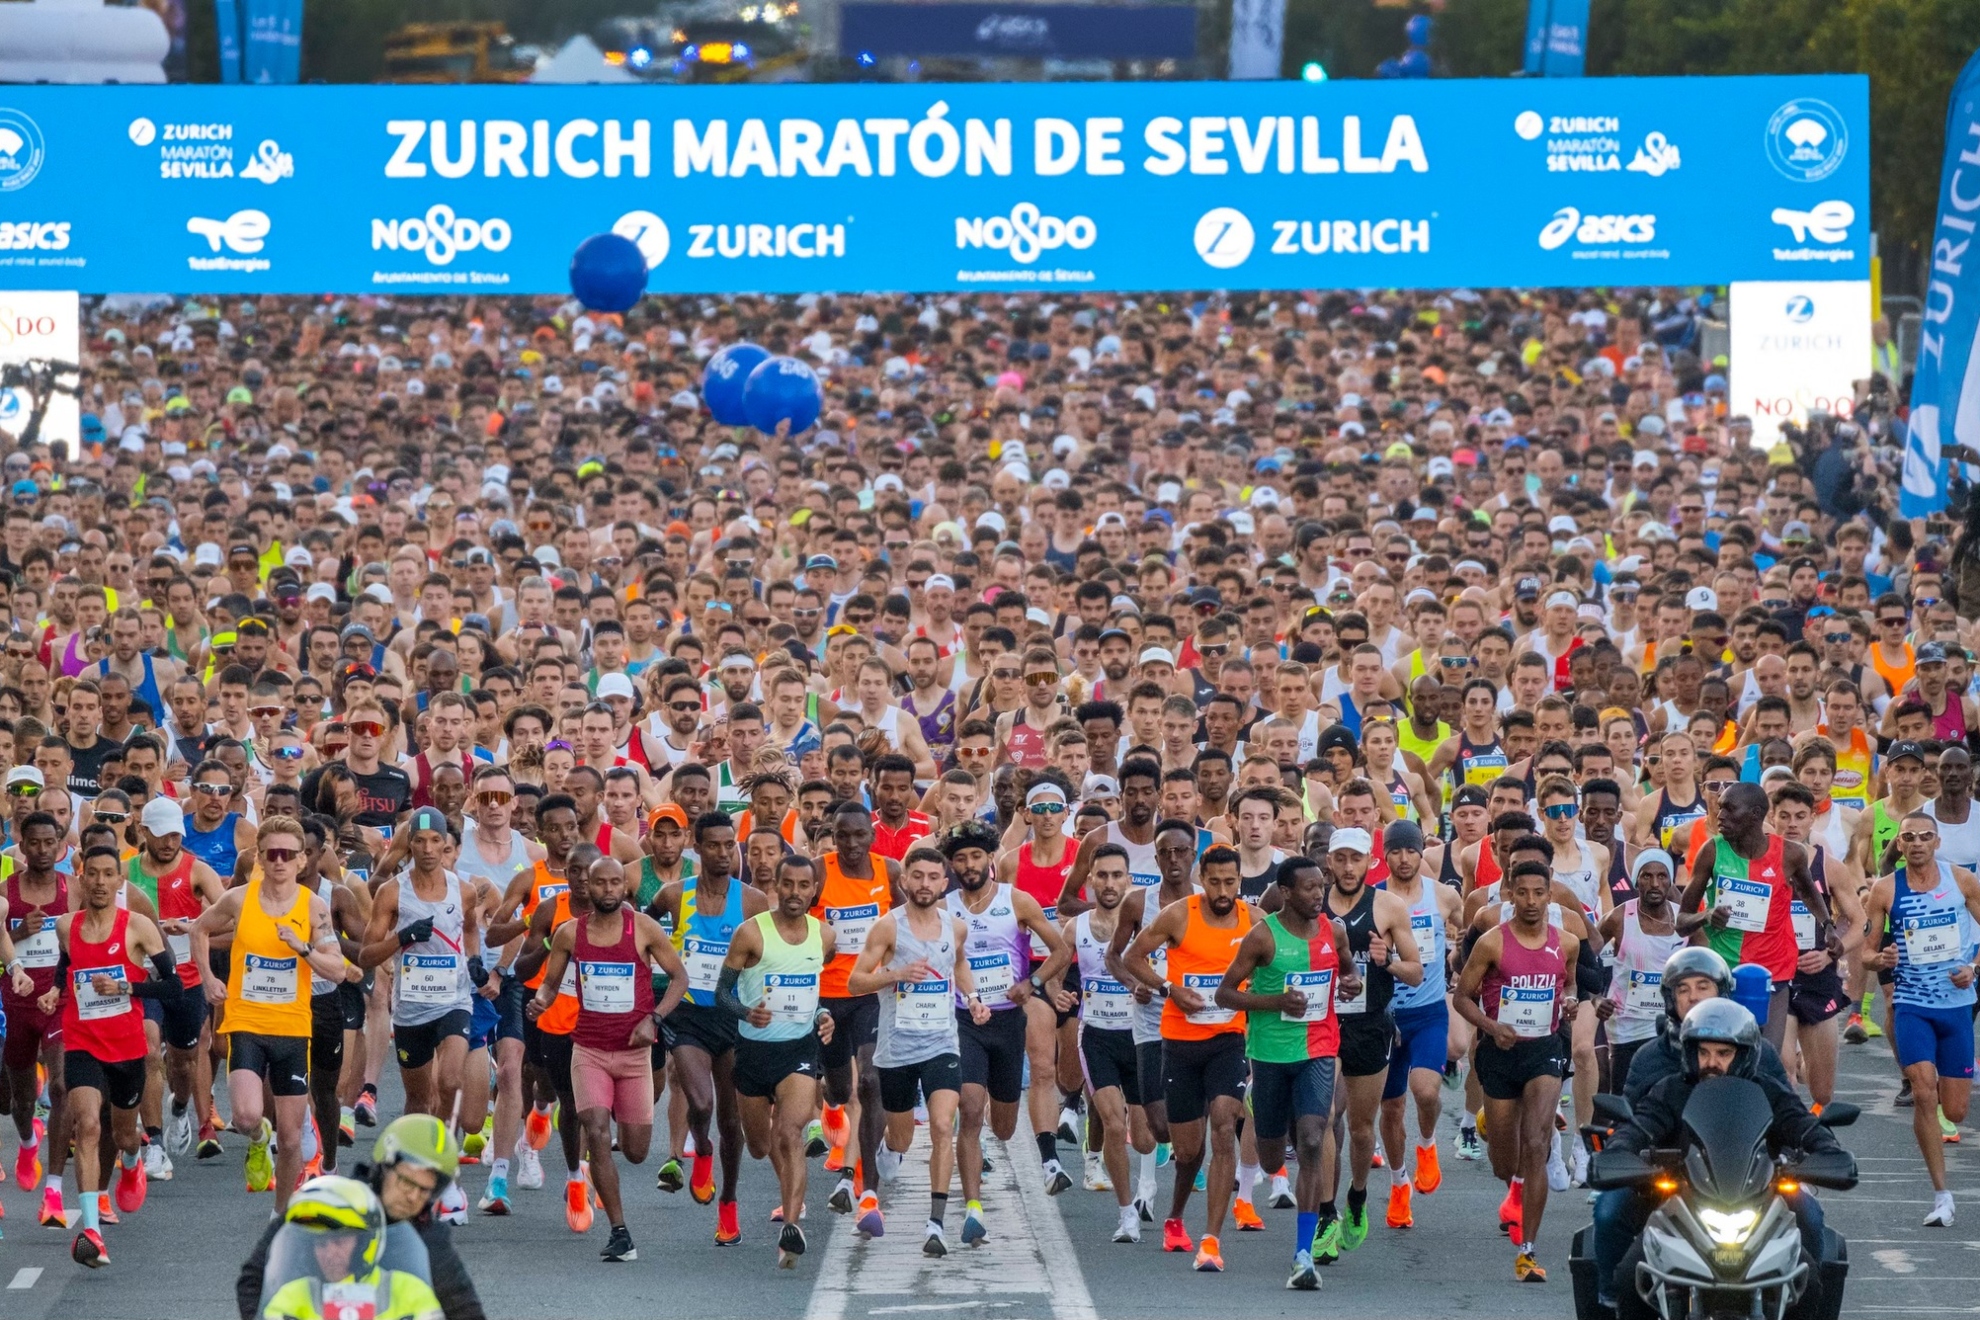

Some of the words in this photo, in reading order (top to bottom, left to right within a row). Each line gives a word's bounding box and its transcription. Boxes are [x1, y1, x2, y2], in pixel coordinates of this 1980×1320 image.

[1548, 116, 1620, 133] ZURICH
[163, 124, 233, 140] ZURICH
[384, 118, 651, 178] ZURICH
[673, 99, 1012, 178] MARATÓN
[1034, 117, 1125, 176] DE
[1143, 115, 1429, 176] SEVILLA
[1547, 136, 1620, 153] MARATÓN
[161, 144, 233, 160] MARATÓN
[1547, 154, 1621, 172] SEVILLA
[160, 161, 234, 178] SEVILLA
[687, 223, 846, 258] ZURICH
[1271, 218, 1430, 254] ZURICH
[1772, 247, 1855, 262] TotalEnergies
[187, 256, 271, 272] TotalEnergies
[1759, 335, 1842, 350] ZURICH
[1734, 883, 1765, 895] ZURICH
[1736, 899, 1746, 908] 38
[1791, 904, 1808, 913] RICH
[843, 908, 873, 918] ZURICH
[1922, 917, 1952, 927] ZURICH
[1928, 934, 1938, 942] 26
[1923, 944, 1946, 953] GELANT
[263, 959, 293, 969] ZURICH
[421, 958, 451, 966] ZURICH
[974, 957, 1004, 968] ZURICH
[597, 966, 628, 975] ZURICH
[424, 974, 434, 982] 60
[784, 976, 812, 985] ZURICH
[1304, 974, 1329, 983] ZURICH
[1511, 973, 1557, 989] POLIZIA
[252, 984, 288, 994] LINKLETTER
[918, 983, 945, 991] ZURICH
[787, 994, 796, 1002] 11
[1307, 992, 1315, 1000] 37
[1520, 992, 1549, 1000] ZURICH
[1105, 1000, 1114, 1008] 79
[1522, 1008, 1532, 1016] 43
[1515, 1018, 1536, 1026] FANIEL
